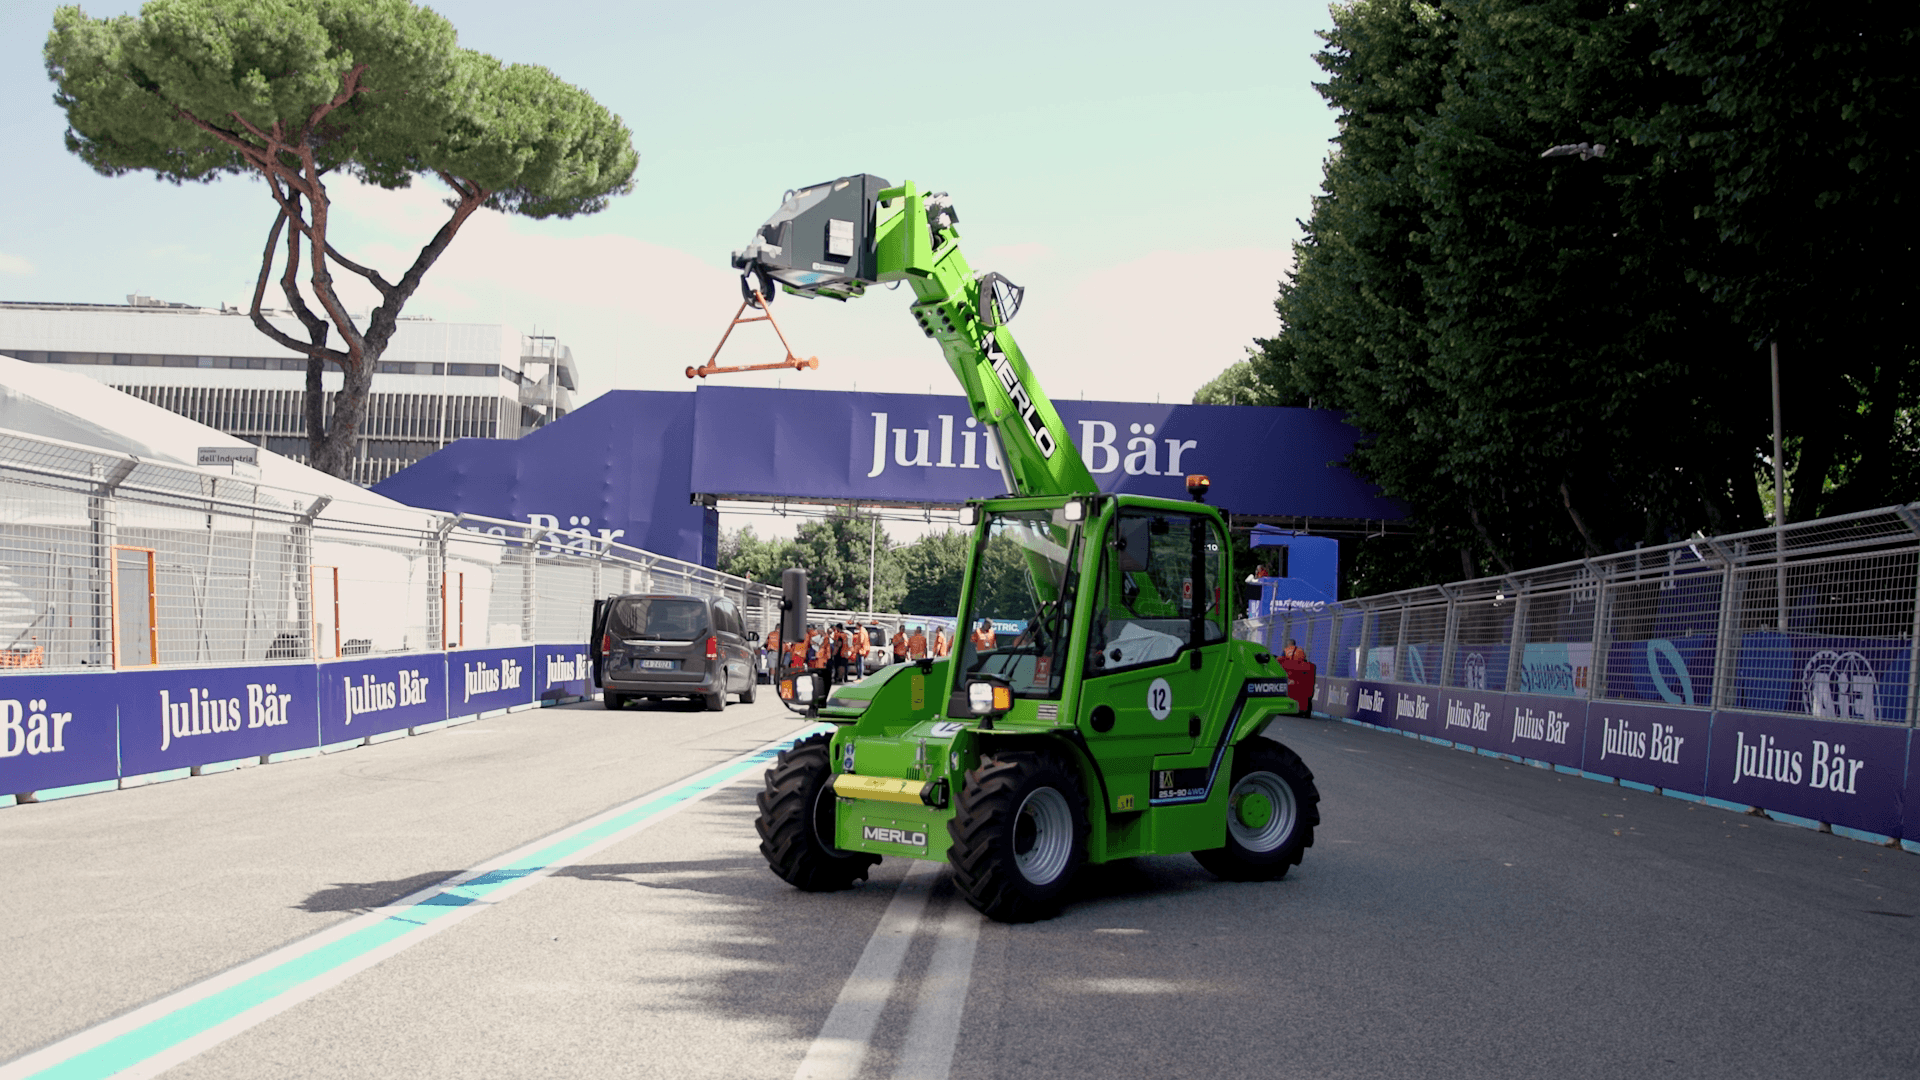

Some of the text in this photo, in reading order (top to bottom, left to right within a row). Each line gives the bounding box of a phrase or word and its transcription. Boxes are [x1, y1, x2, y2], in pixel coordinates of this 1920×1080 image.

[981, 331, 1057, 458] MERLO
[868, 412, 1197, 478] Juli Bär
[527, 514, 625, 560] Bär
[464, 659, 522, 703] Julius Bär
[546, 654, 575, 690] Julius
[160, 684, 291, 751] Julius Bär
[344, 670, 429, 725] Julius Bär
[1152, 688, 1166, 711] 12
[1357, 688, 1384, 713] Julius Bär
[1396, 693, 1430, 720] Julius Bär
[1445, 699, 1491, 731] Julius Bär
[0, 699, 72, 757] Bär
[1512, 707, 1570, 744] Julius Bär
[1600, 718, 1684, 764] Julius Bär
[1733, 732, 1864, 794] Julius Bär
[864, 827, 925, 845] MERLO
